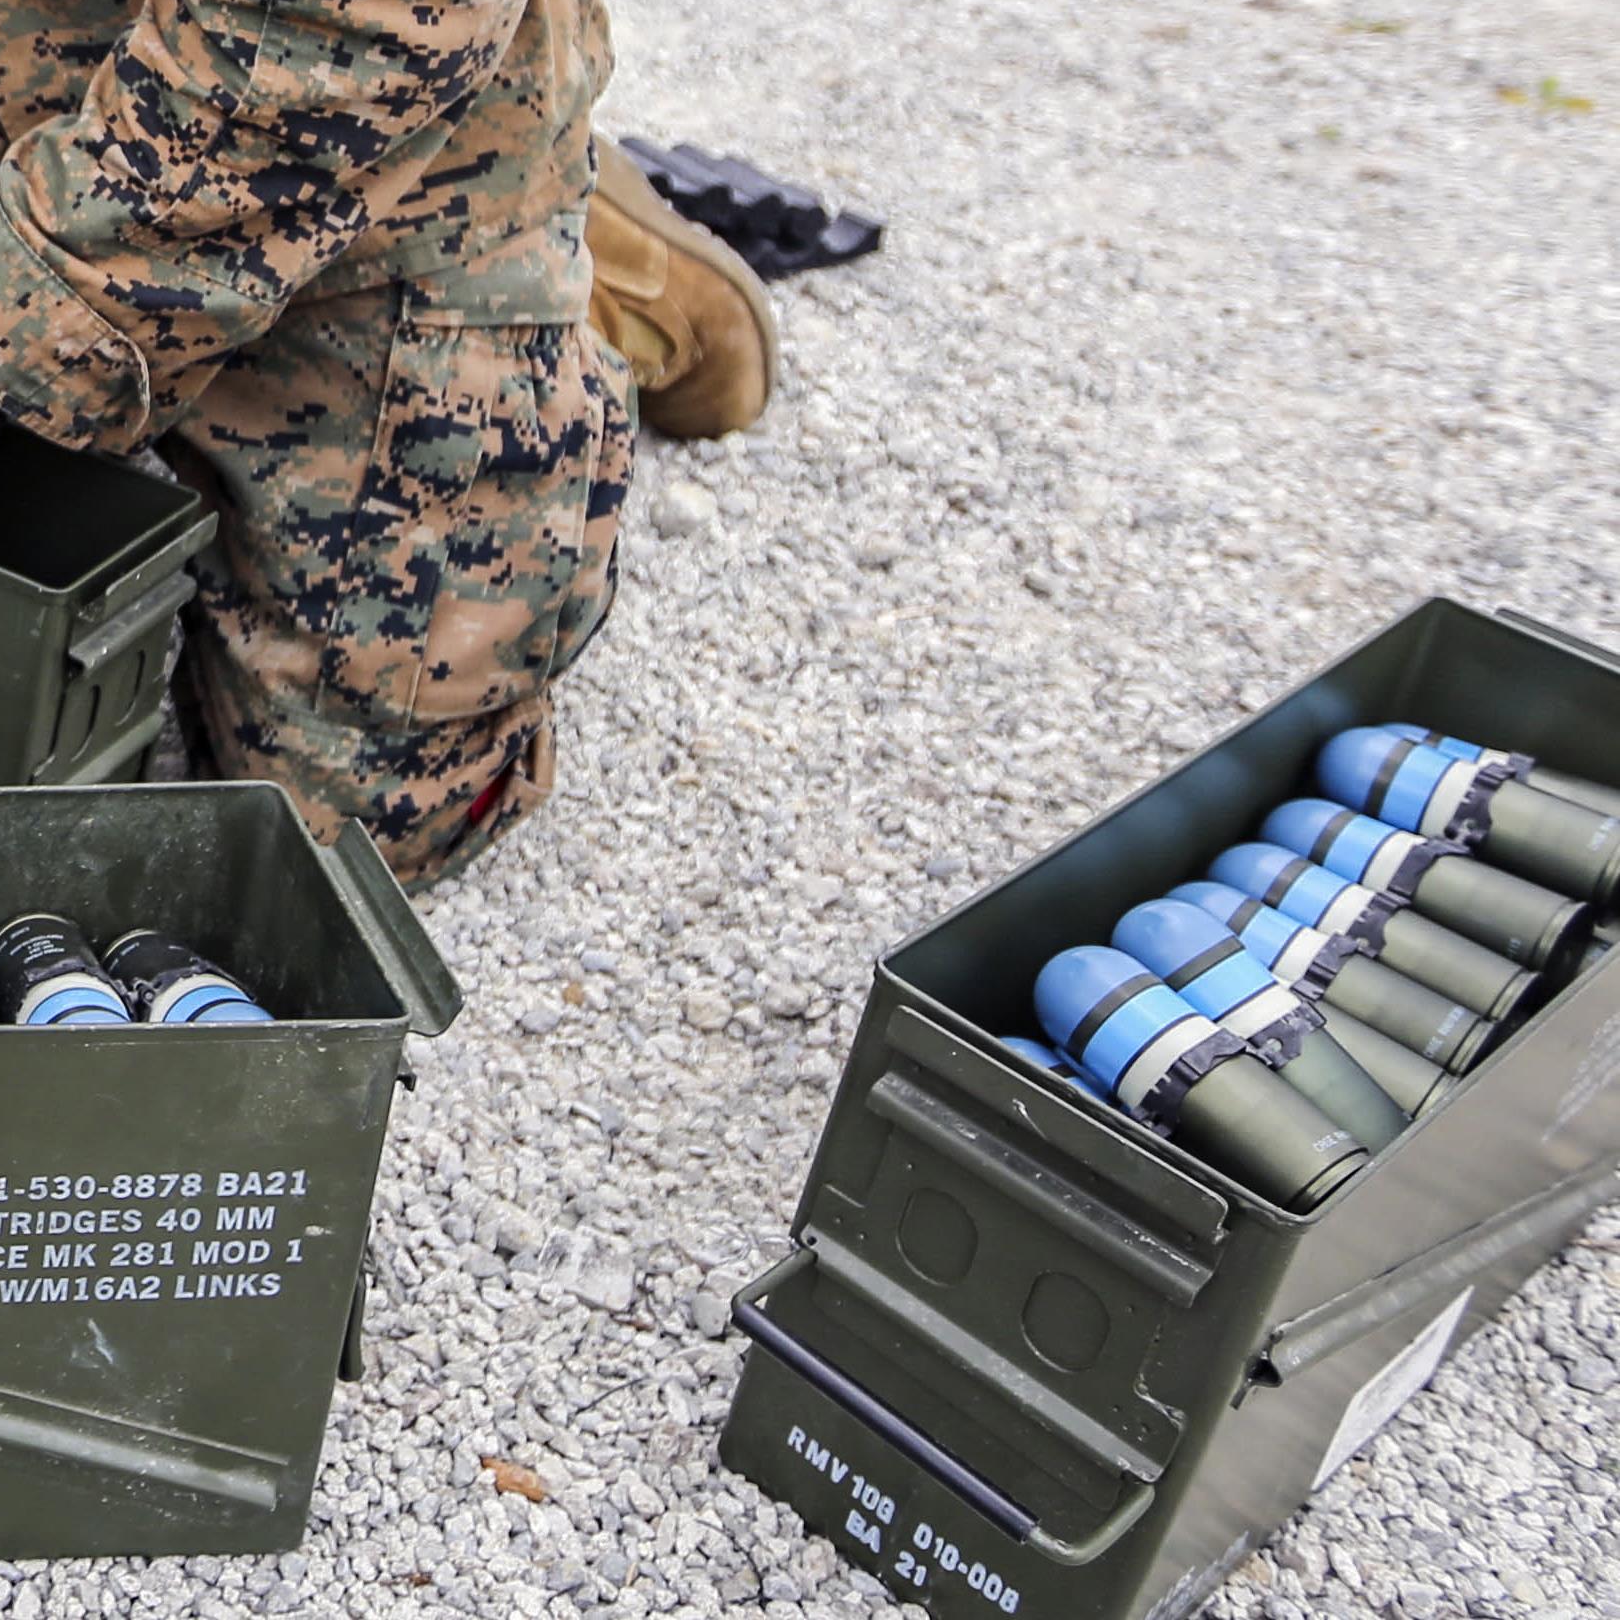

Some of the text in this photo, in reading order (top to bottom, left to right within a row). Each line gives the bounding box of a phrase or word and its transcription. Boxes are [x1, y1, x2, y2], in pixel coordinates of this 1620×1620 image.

[216, 1170, 307, 1198] BA21
[156, 1208, 201, 1232] 40
[215, 1206, 275, 1231] MM
[42, 1243, 97, 1268] MK
[110, 1241, 174, 1267] 281
[192, 1239, 270, 1265] MOD
[285, 1238, 303, 1263] 1
[0, 1276, 160, 1303] W/M16A2
[174, 1273, 281, 1300] LINKS
[845, 1509, 926, 1586] BA 21
